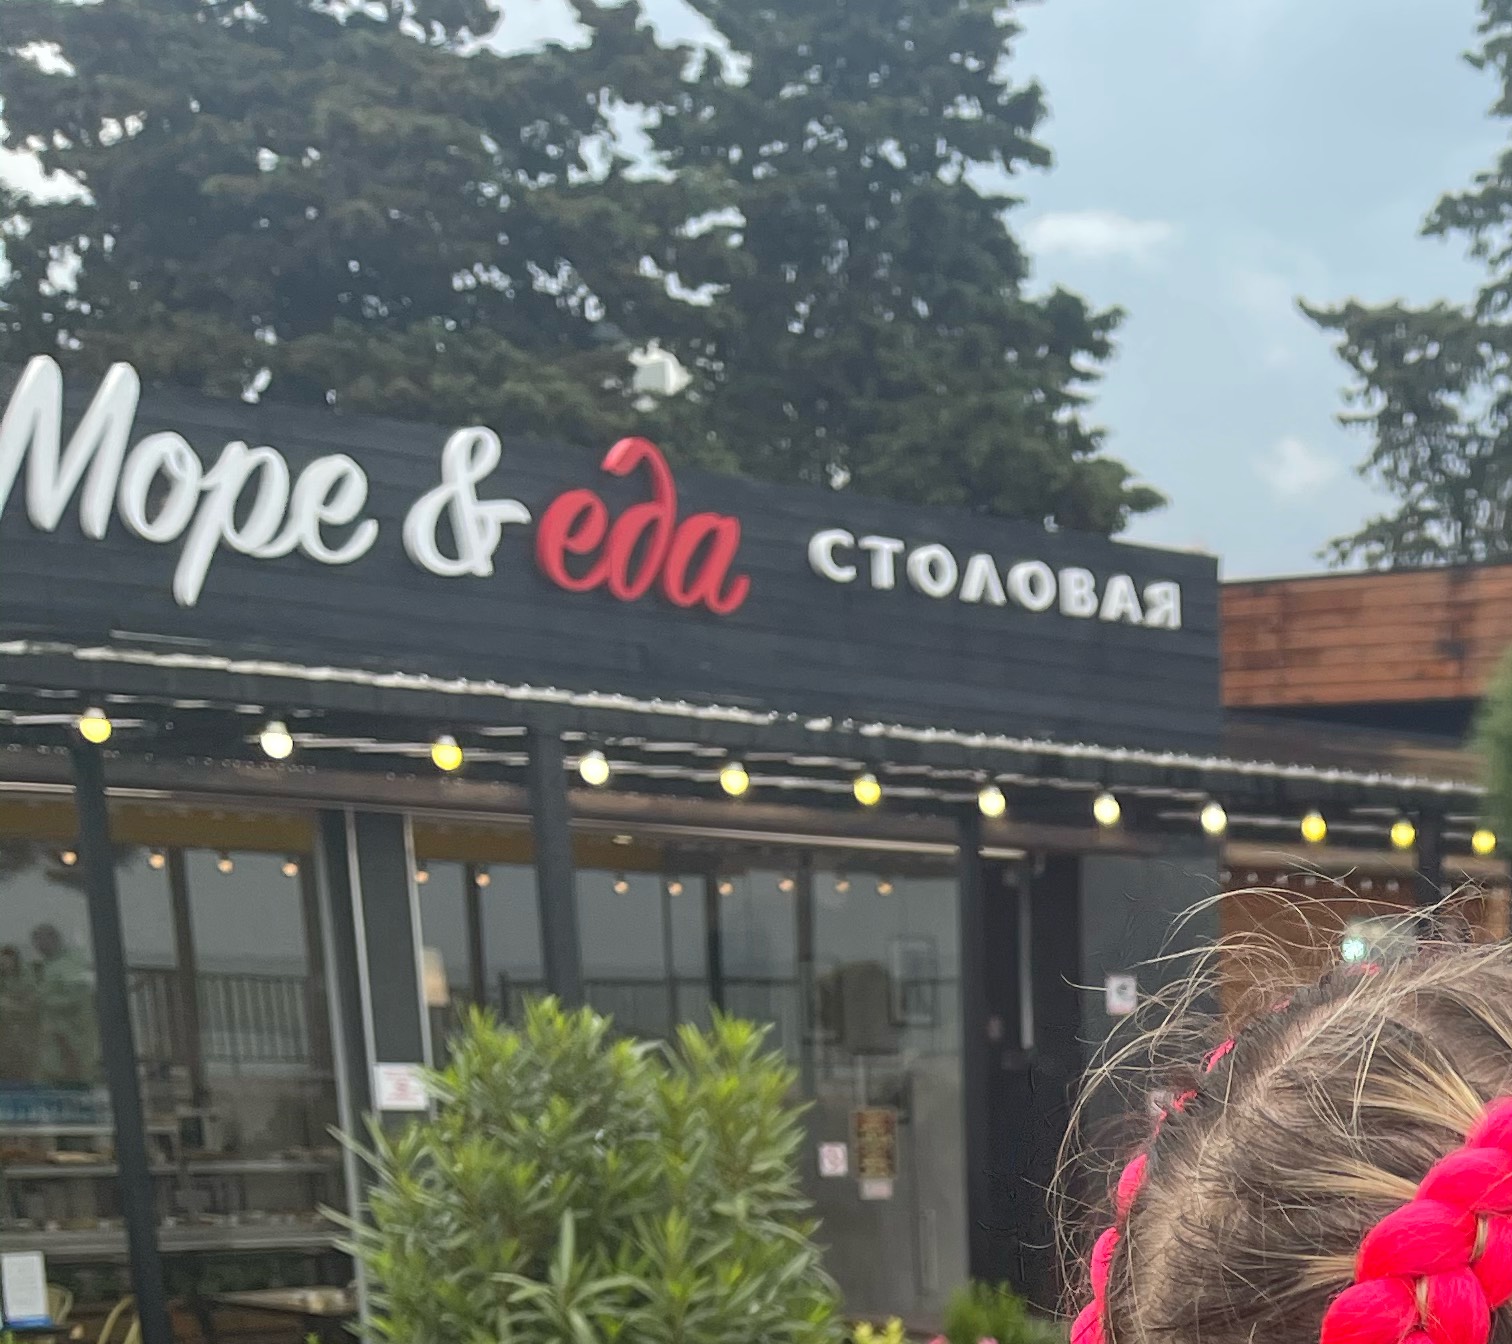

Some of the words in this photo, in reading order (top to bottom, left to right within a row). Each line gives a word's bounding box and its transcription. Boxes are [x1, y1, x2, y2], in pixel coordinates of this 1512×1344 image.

[0, 354, 379, 607] Море
[403, 425, 531, 577] &
[536, 436, 751, 615] еда
[806, 526, 1183, 630] СТОЛОВАЯ
